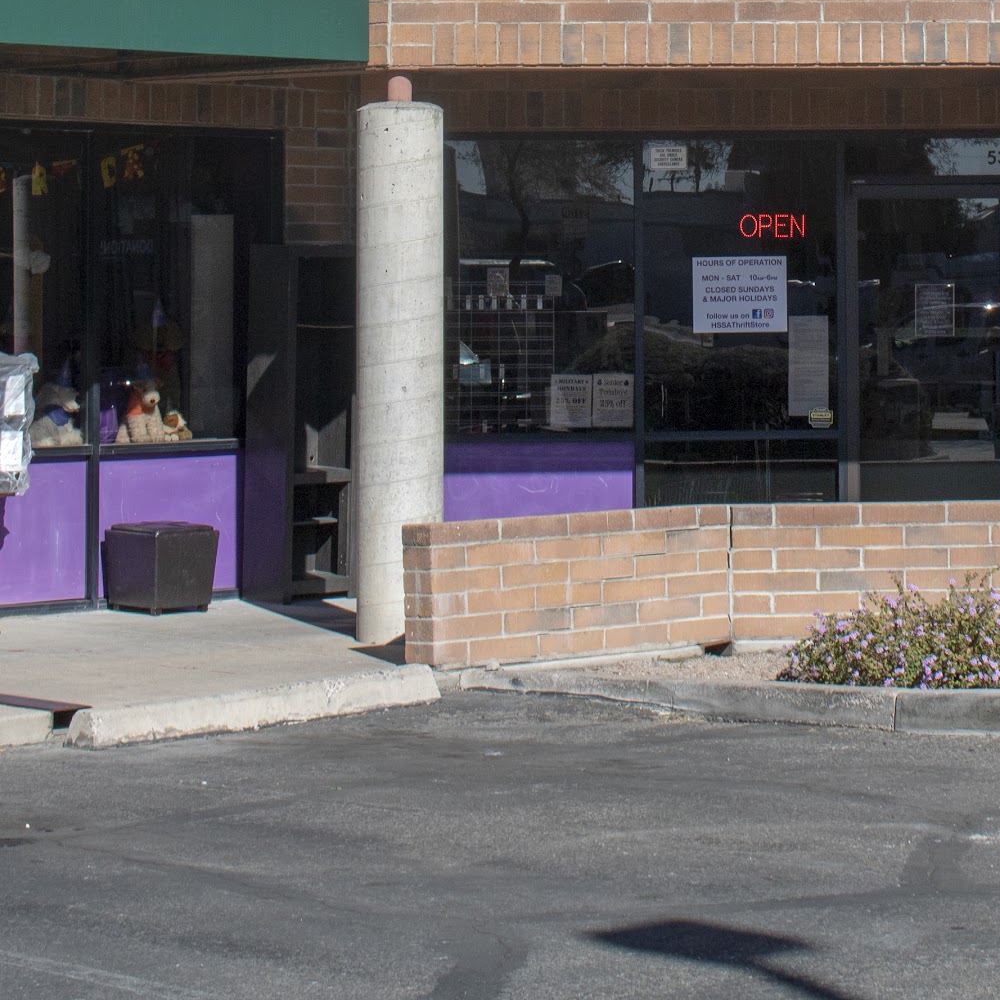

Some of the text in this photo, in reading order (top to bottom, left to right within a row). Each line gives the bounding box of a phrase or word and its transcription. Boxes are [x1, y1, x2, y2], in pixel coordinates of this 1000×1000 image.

[739, 214, 806, 238] OPEN
[696, 259, 724, 267] HOURS
[738, 258, 783, 266] OPERATION
[706, 312, 729, 320] follow
